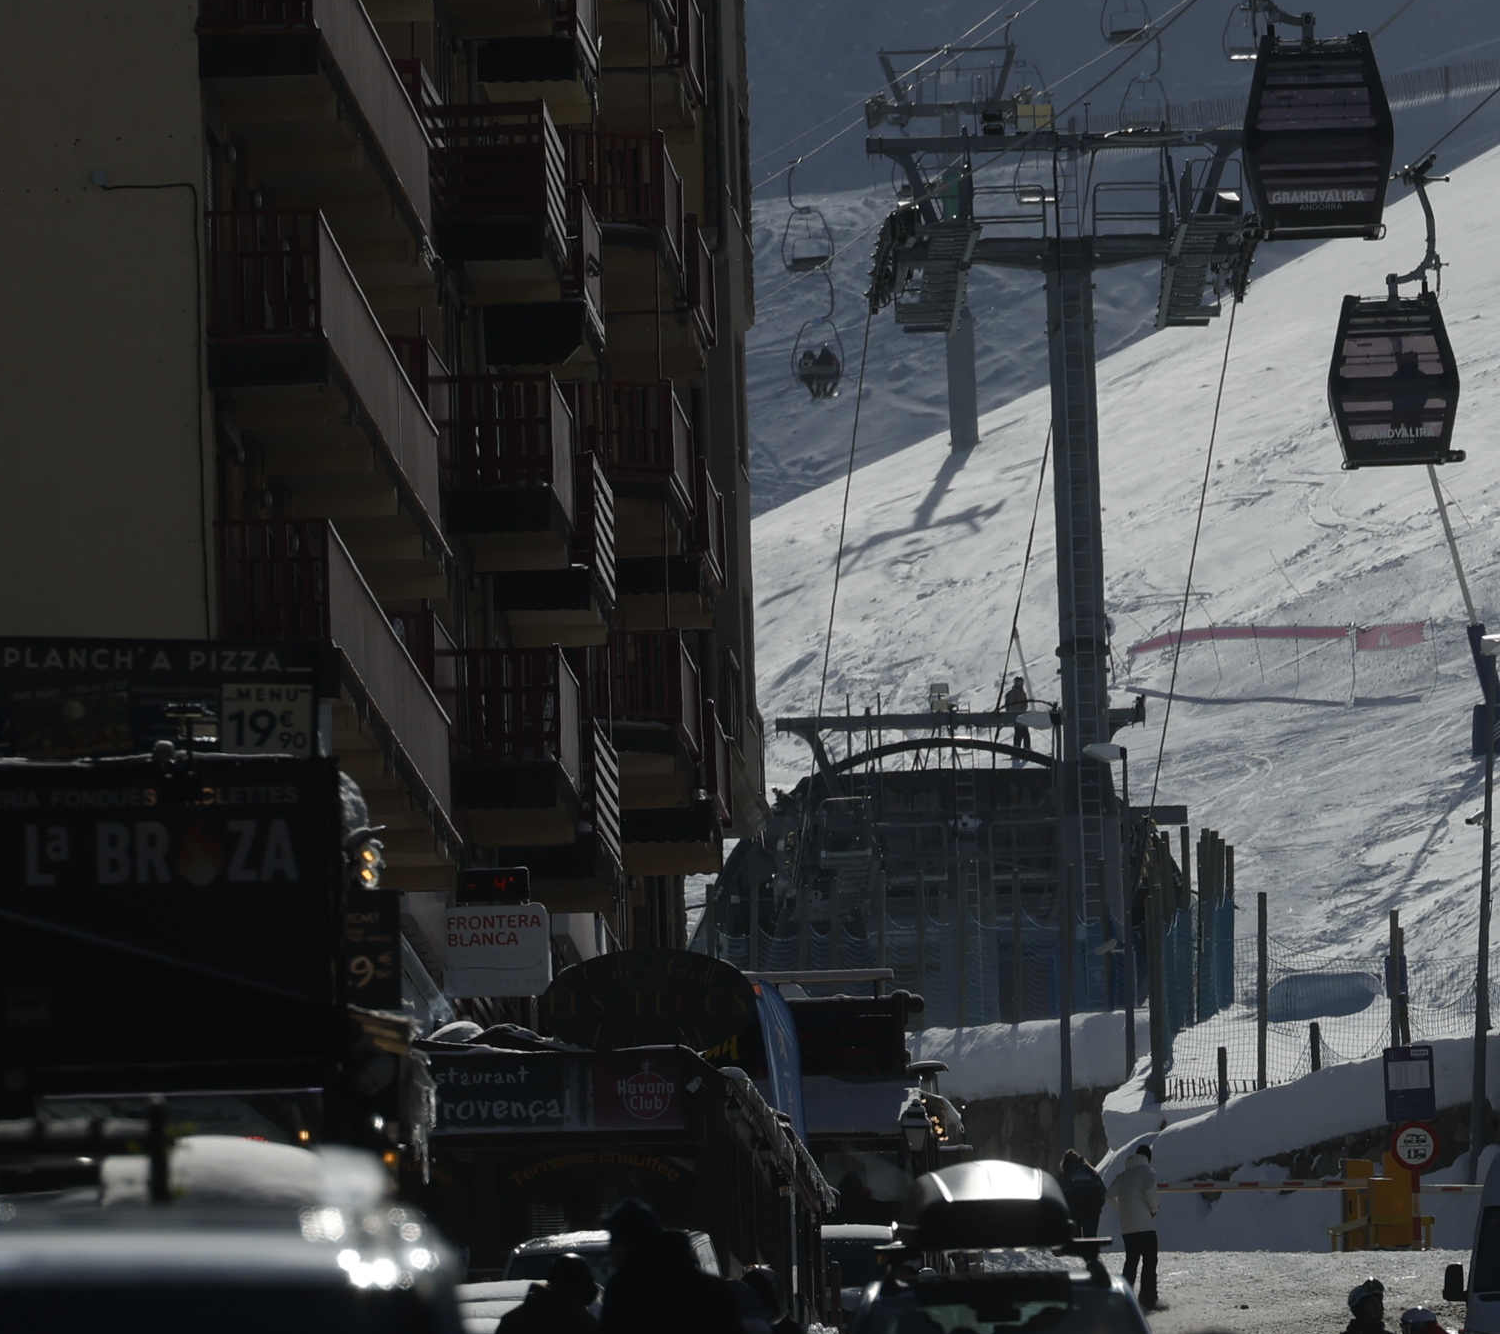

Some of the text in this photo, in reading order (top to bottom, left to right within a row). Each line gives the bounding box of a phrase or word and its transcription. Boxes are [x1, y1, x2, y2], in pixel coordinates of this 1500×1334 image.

[1271, 188, 1366, 206] GRANDVALIRA
[1298, 202, 1344, 212] ANDORRA
[1355, 426, 1436, 441] GRANDVALIRA
[1377, 438, 1416, 447] ANDORRA
[188, 650, 282, 673] PIZZA
[237, 687, 299, 702] MENU
[50, 786, 159, 809] FONDUES
[446, 913, 542, 931] FRONTERA
[447, 931, 519, 948] BLANCA
[548, 989, 748, 1017] ELS FLOCS
[616, 1079, 676, 1096] Havana
[628, 1094, 664, 1112] Club
[508, 1150, 681, 1186] Terrasse chauffée
